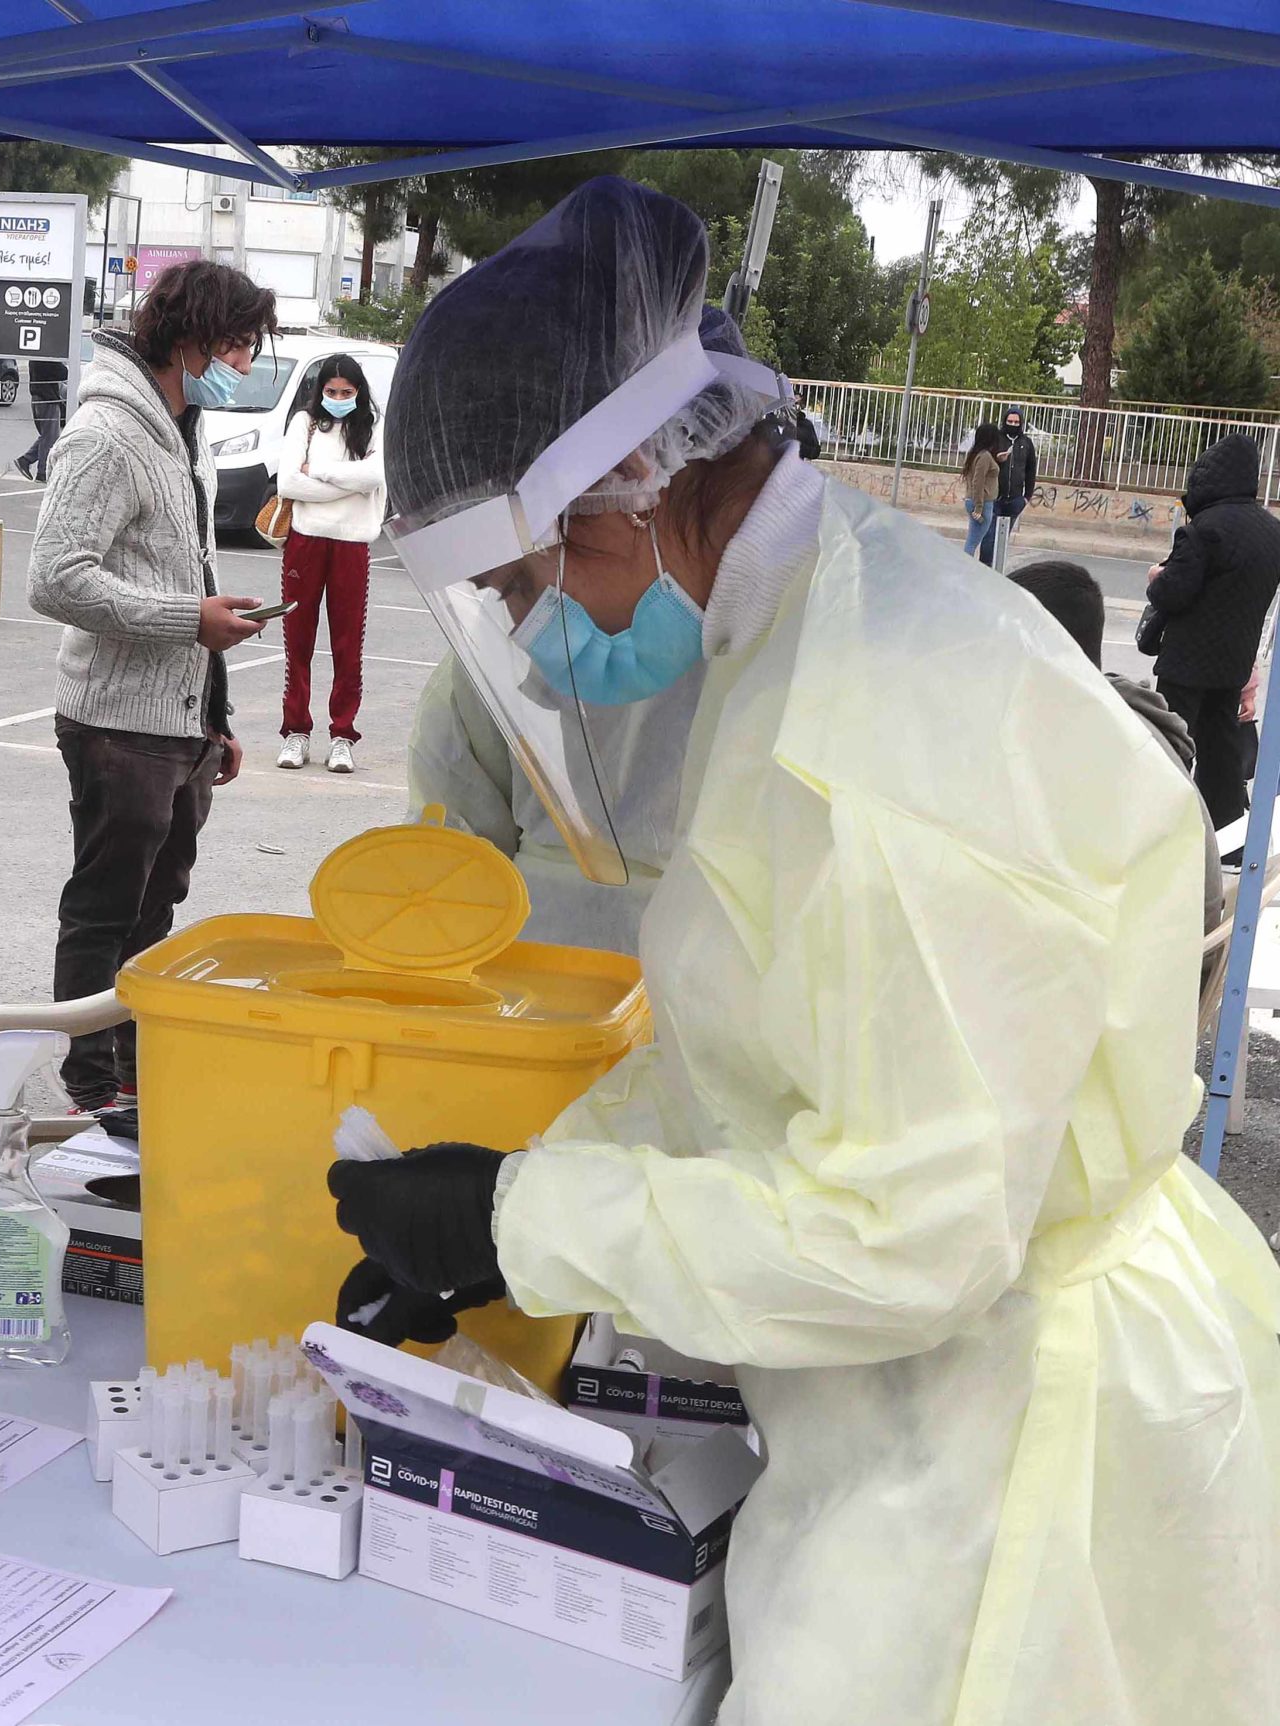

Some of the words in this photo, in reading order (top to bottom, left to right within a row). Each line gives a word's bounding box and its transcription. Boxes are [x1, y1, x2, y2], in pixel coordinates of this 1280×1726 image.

[19, 251, 51, 271] τιμές!
[148, 249, 188, 258] AIMILIANA
[23, 329, 37, 346] P
[86, 1241, 111, 1253] GLOVES
[606, 1388, 646, 1400] COVID-19
[660, 1394, 688, 1405] RAPID
[689, 1398, 709, 1408] TEST
[710, 1400, 743, 1411] DEVICE
[397, 1470, 439, 1490] COVID-19
[454, 1487, 482, 1504] RAPID
[483, 1495, 505, 1510] TEST
[504, 1501, 538, 1521] DEVICE
